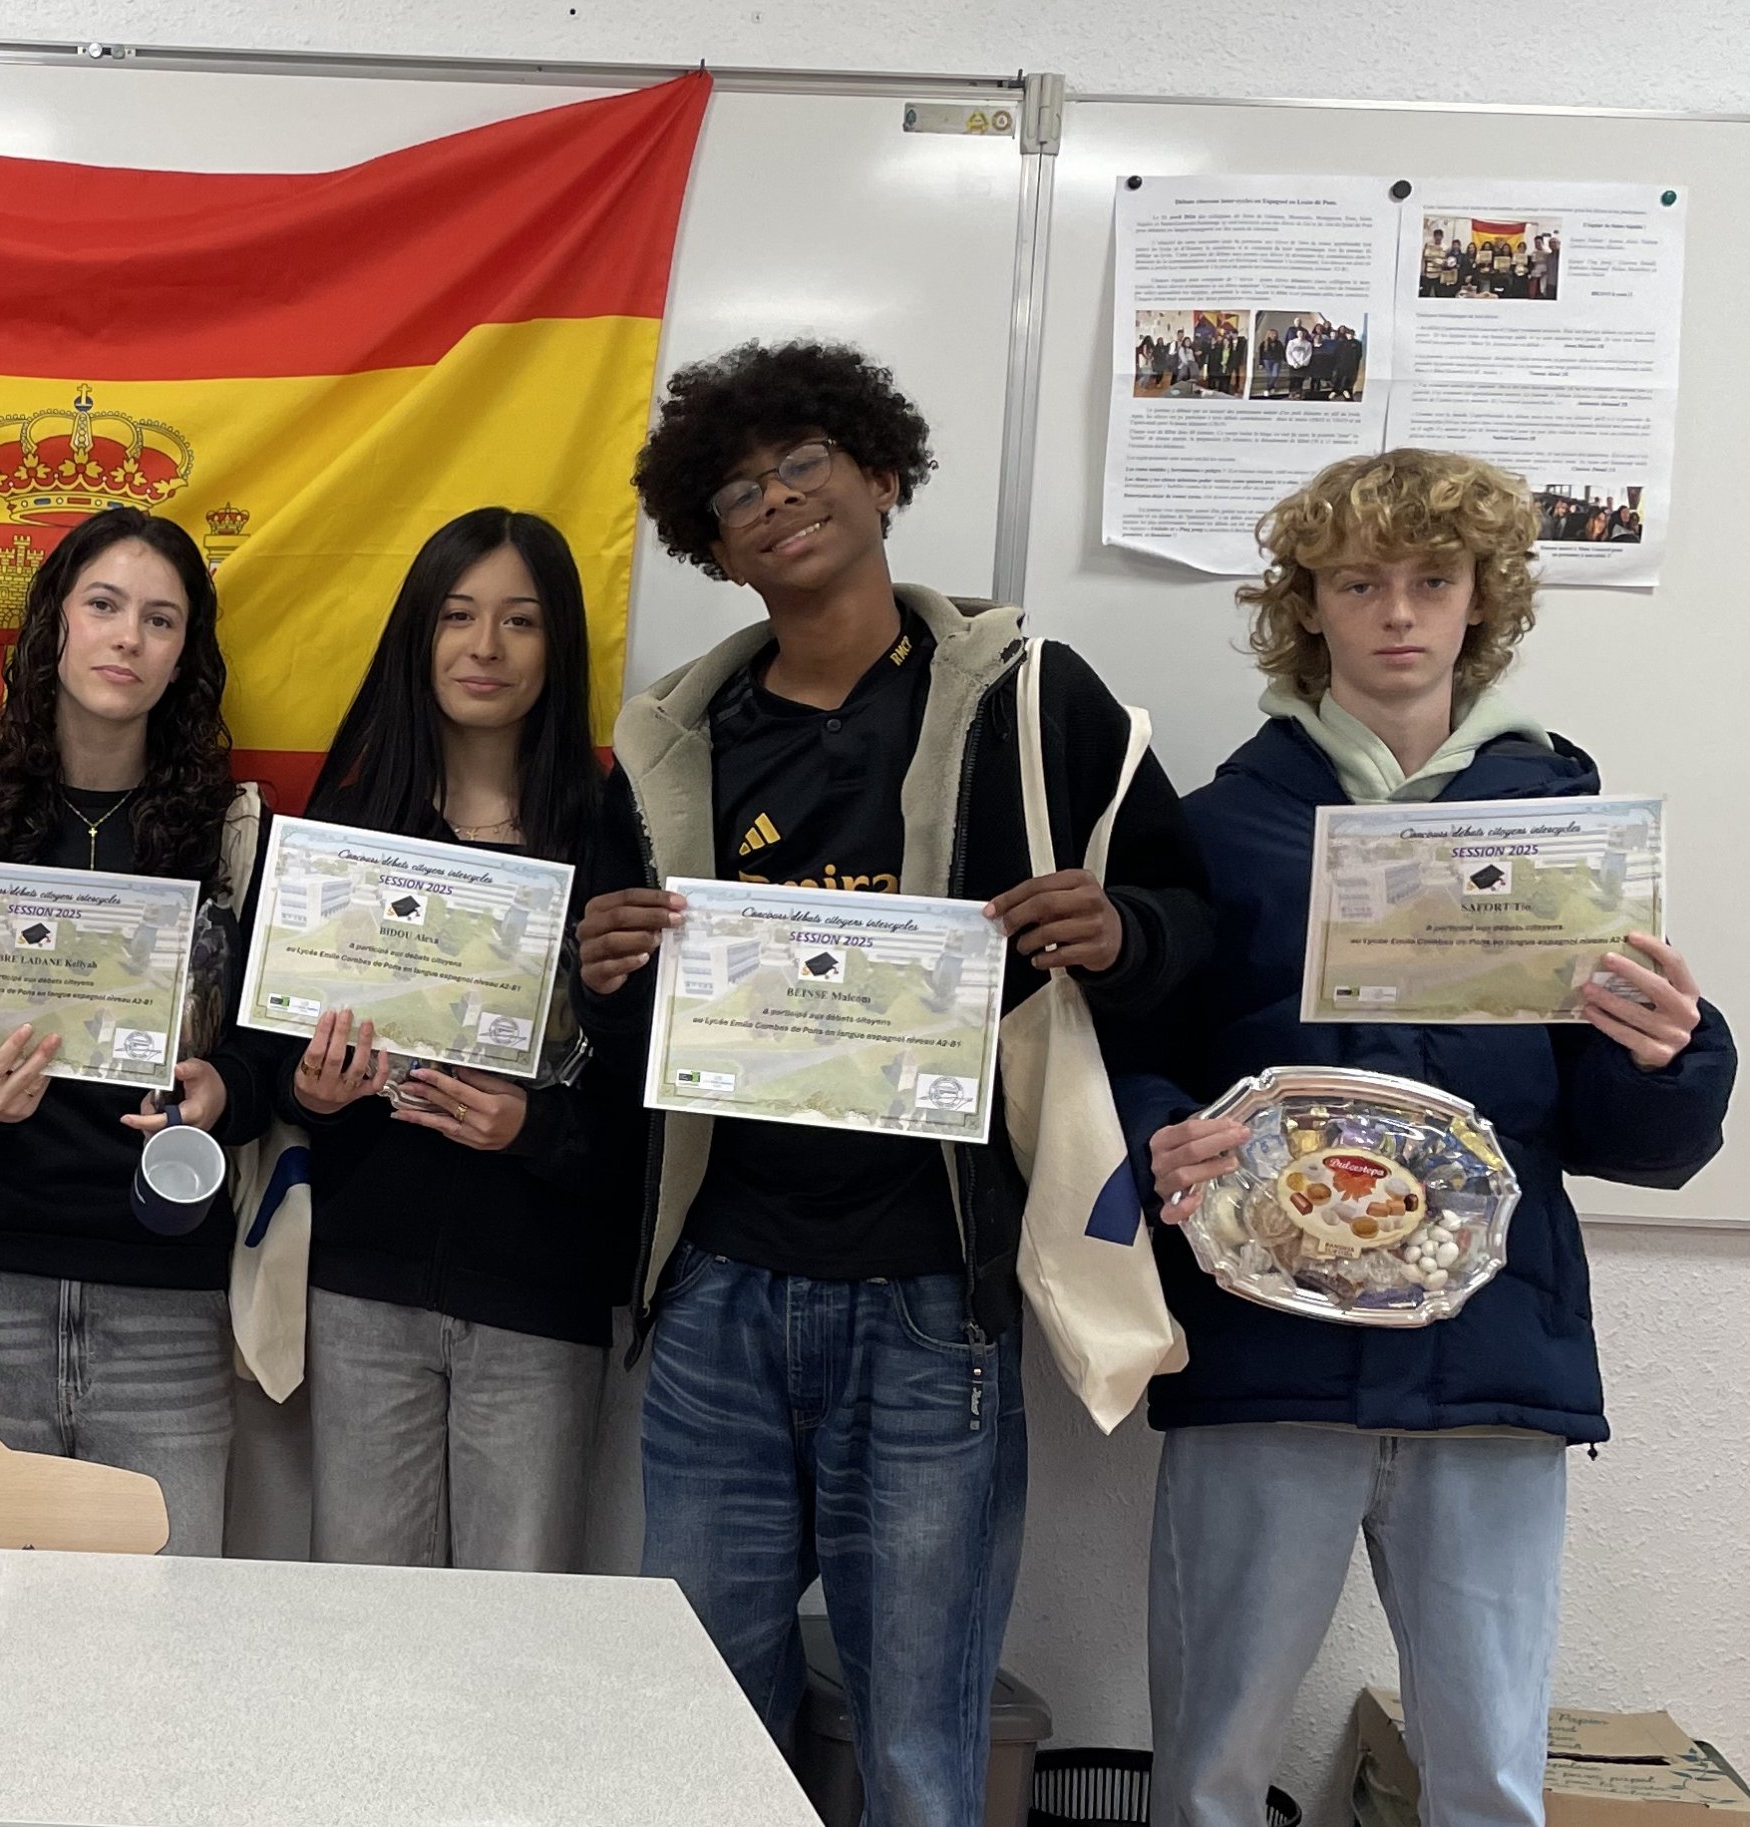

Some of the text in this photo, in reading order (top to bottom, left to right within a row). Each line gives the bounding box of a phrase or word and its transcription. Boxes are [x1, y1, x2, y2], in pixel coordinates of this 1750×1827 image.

[1451, 844, 1539, 858] SESSION 2025
[337, 849, 379, 863] Concours
[411, 861, 445, 875] citoyens
[447, 867, 493, 883] intercycles
[378, 874, 453, 894] SESSION 2025
[7, 905, 82, 918] SESSION 2025
[379, 926, 413, 940] BIDOU
[789, 931, 874, 947] SESSION 2025
